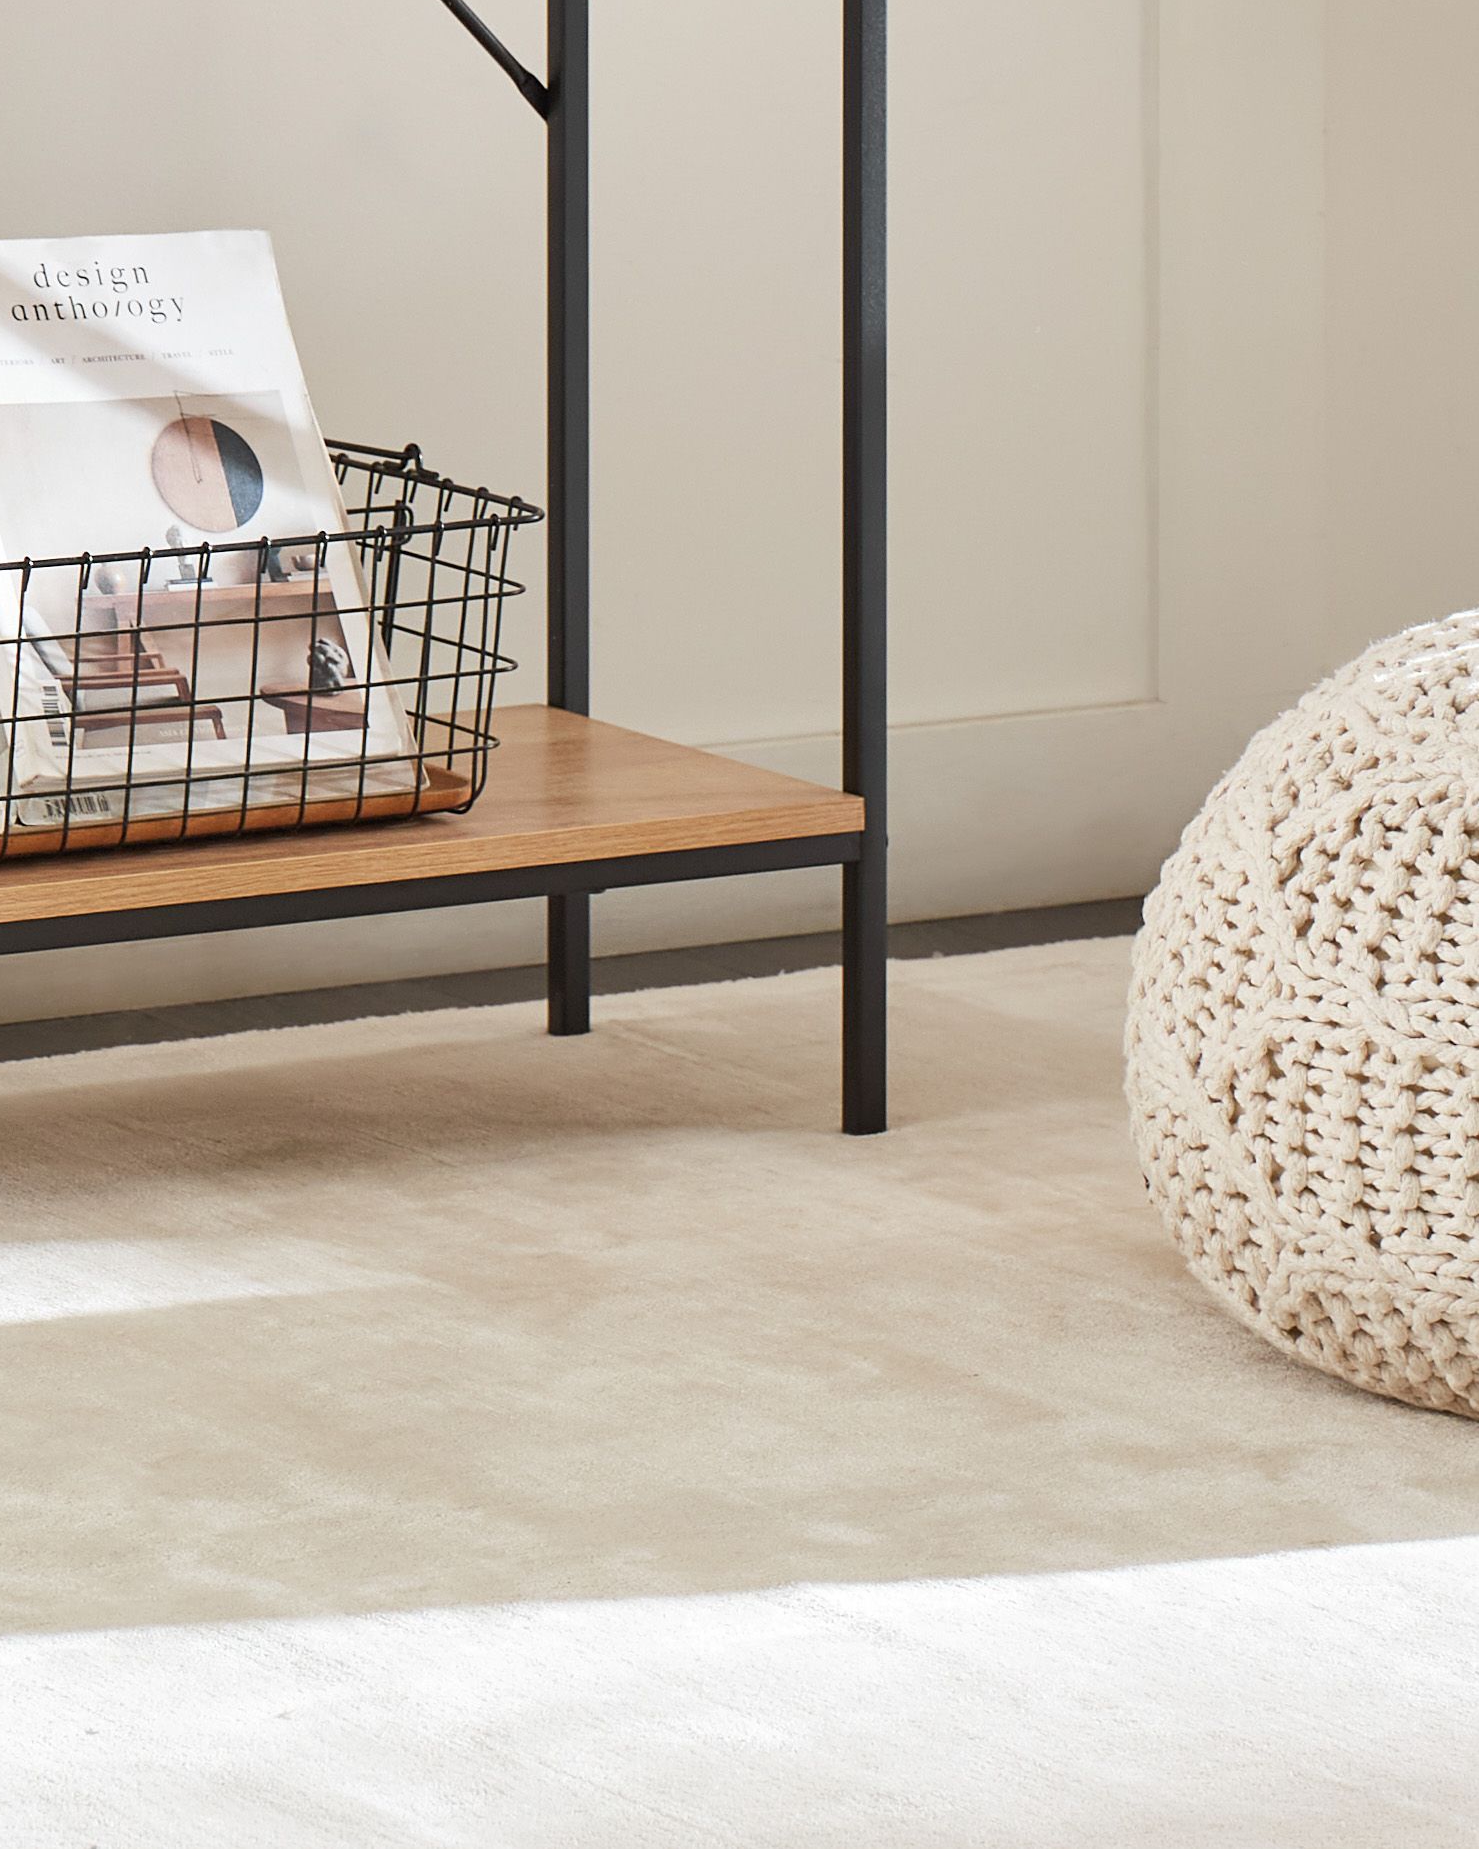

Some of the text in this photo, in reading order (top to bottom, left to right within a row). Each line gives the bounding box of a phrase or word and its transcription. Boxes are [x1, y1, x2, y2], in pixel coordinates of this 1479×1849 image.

[34, 261, 150, 293] design
[51, 357, 65, 365] ART
[82, 354, 146, 363] ARCHITECTURE
[161, 351, 192, 359] TRAVEL
[209, 348, 233, 357] STYLE
